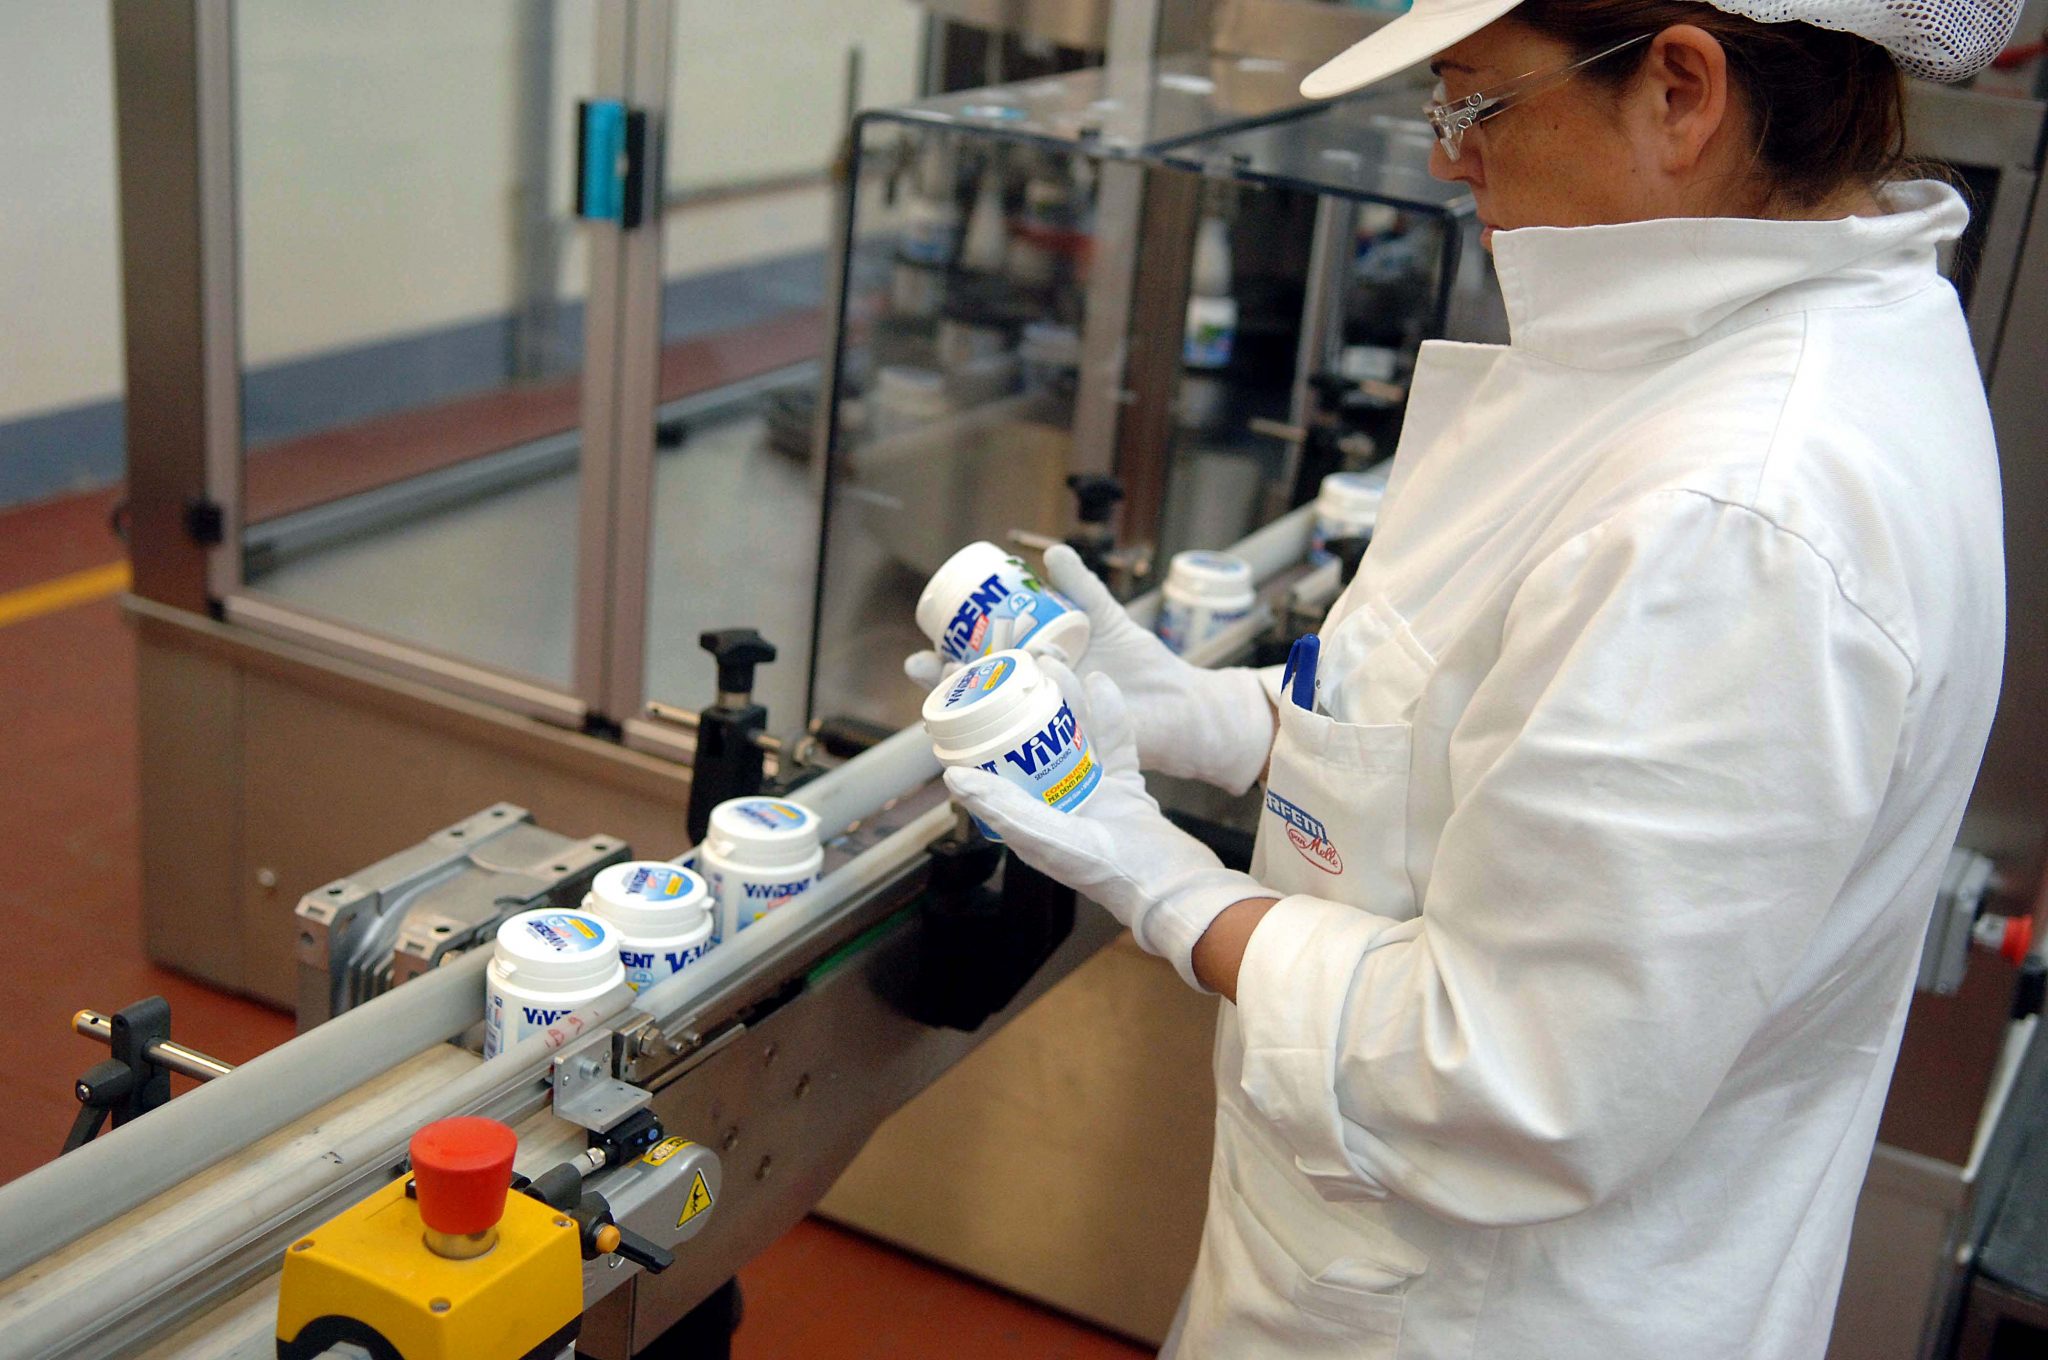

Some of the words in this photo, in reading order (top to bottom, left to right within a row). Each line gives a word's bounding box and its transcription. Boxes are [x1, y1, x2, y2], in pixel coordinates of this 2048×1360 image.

[1034, 768, 1051, 781] SENZA
[1050, 748, 1072, 770] ZUCCHERO
[1045, 781, 1064, 798] CON
[1048, 793, 1060, 803] PER
[1059, 779, 1076, 795] DENTI
[1311, 836, 1339, 868] Melle
